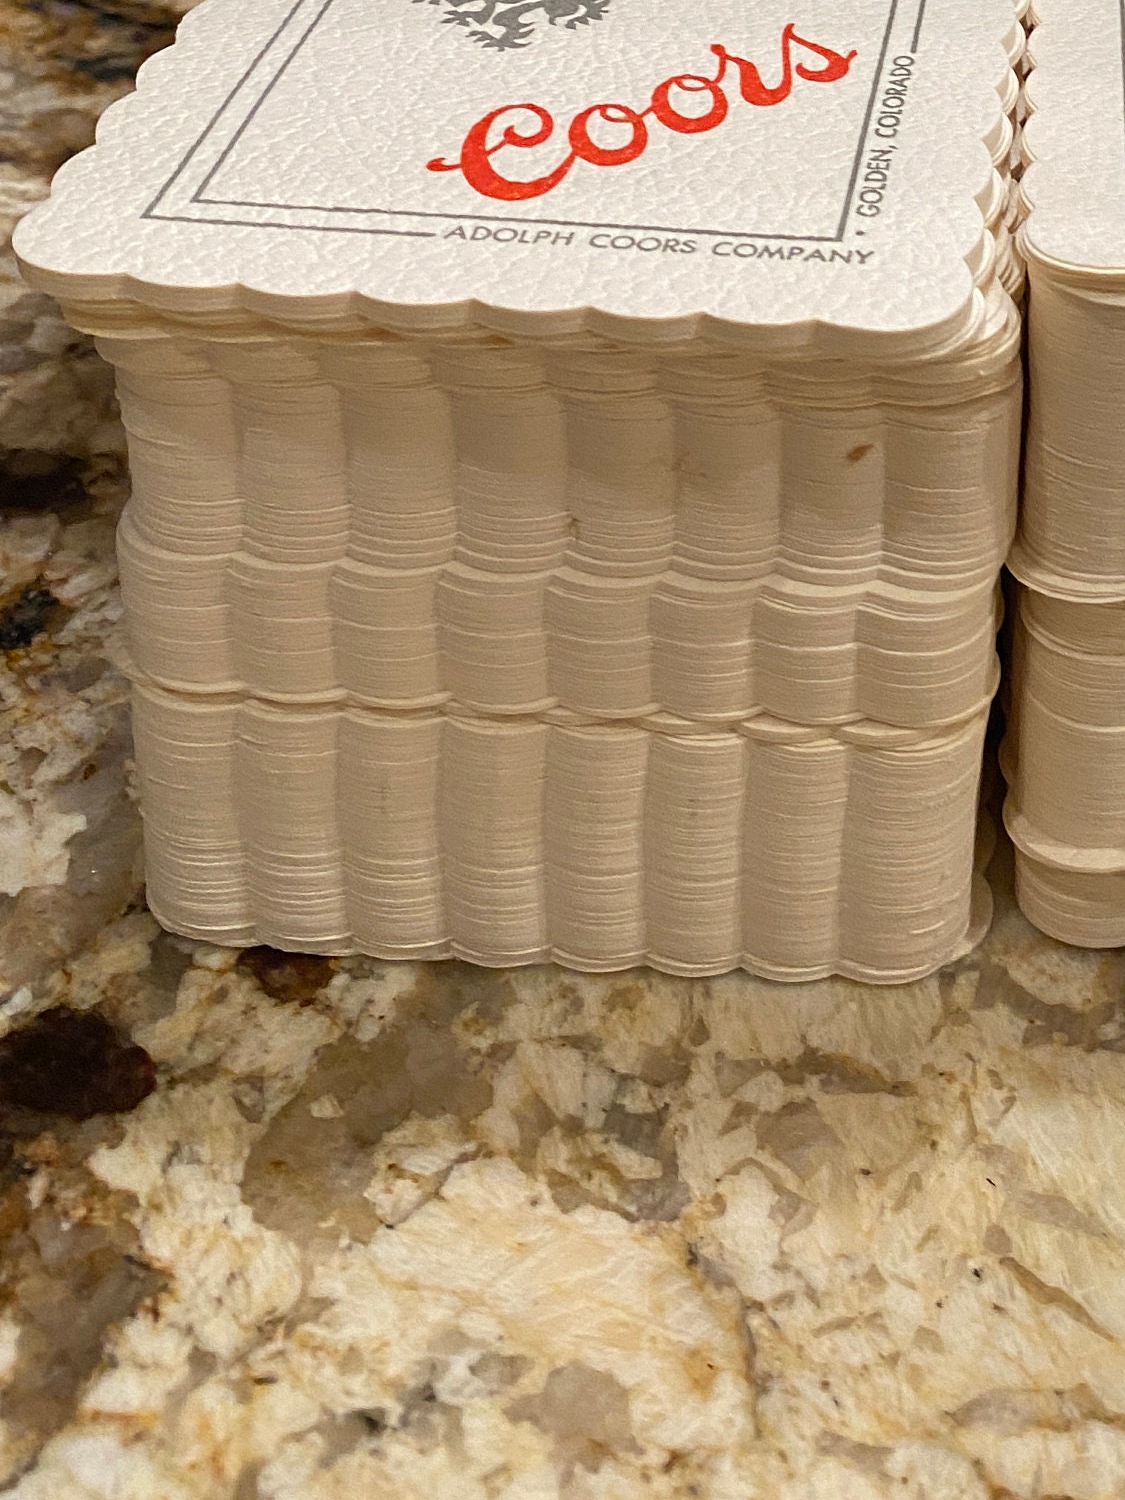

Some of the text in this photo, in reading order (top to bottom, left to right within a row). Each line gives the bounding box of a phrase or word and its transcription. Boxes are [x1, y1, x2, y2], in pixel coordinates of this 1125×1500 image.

[425, 22, 858, 201] Coors
[855, 55, 915, 218] GOLDEN, COLORADO
[444, 225, 875, 265] ADOLPH COORS COMPANY
